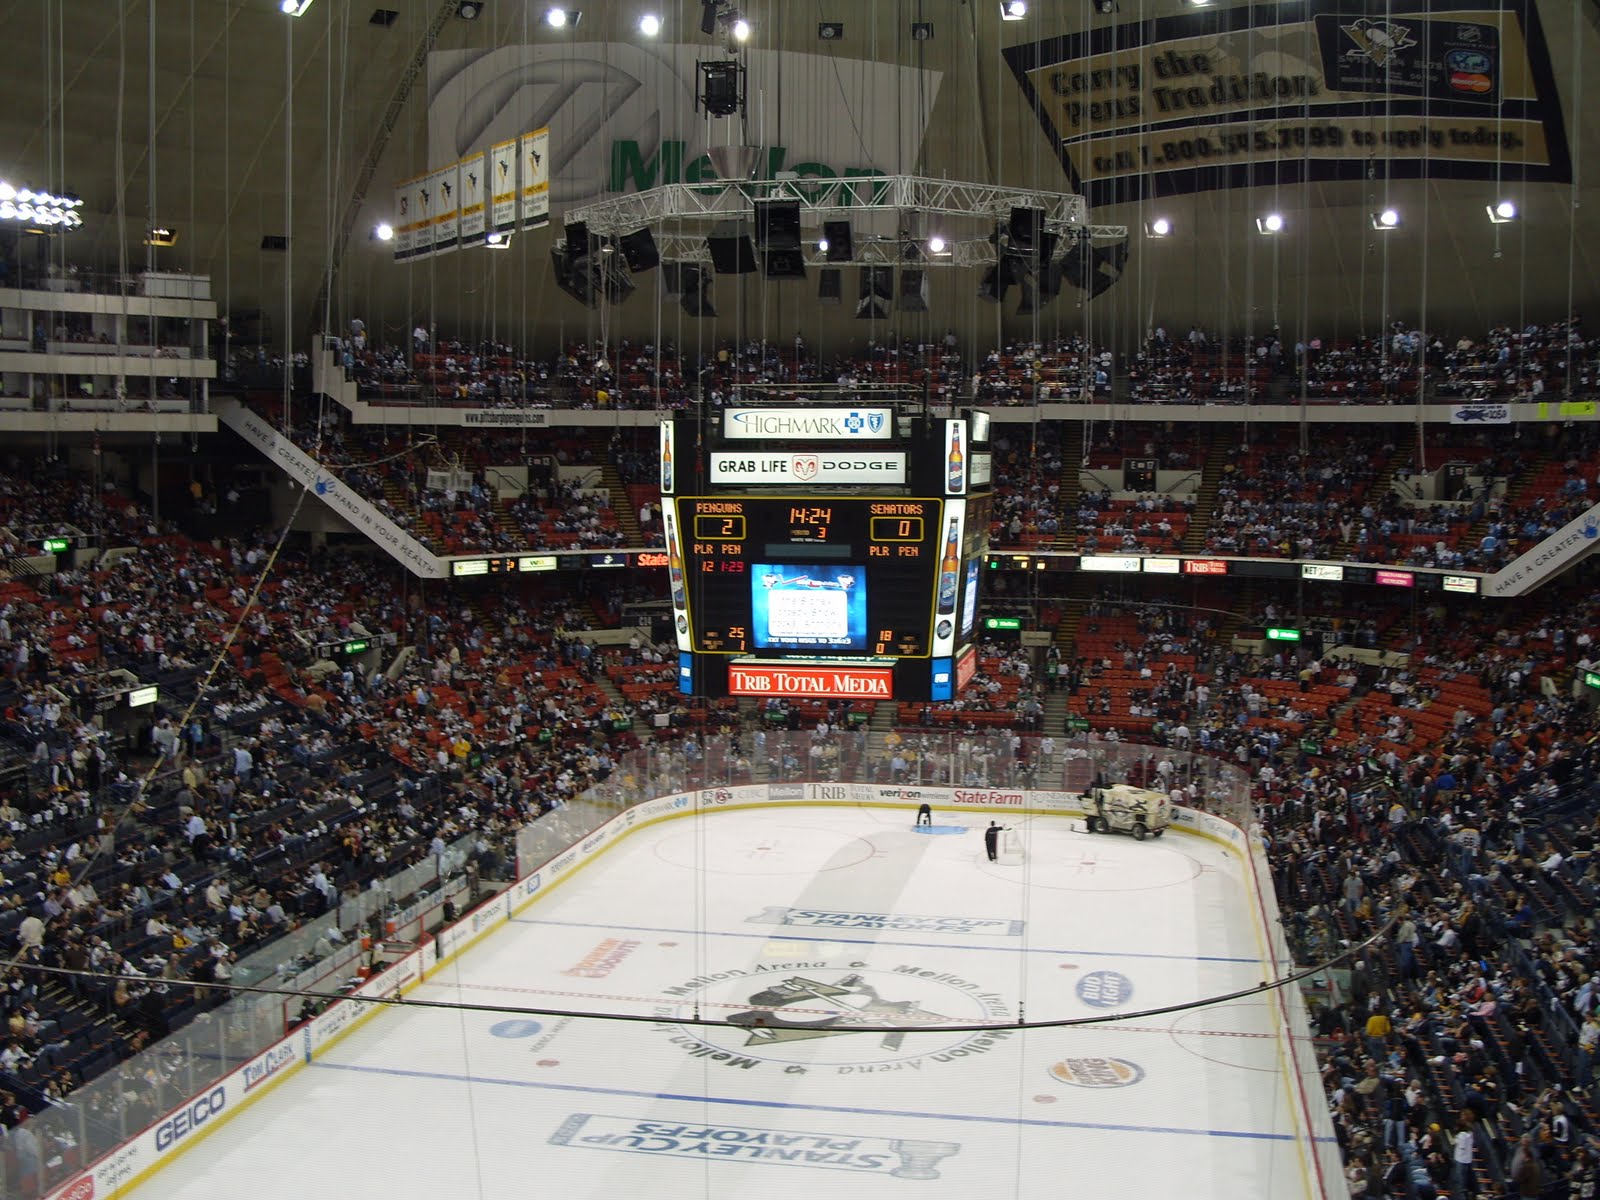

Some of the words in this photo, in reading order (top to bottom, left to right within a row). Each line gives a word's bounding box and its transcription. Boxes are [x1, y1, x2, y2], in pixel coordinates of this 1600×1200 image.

[1052, 63, 1142, 97] Carry
[1152, 50, 1212, 79] the
[1152, 72, 1320, 112] Tradition
[738, 411, 842, 436] HIGHMARK
[718, 460, 756, 473] GRAB
[761, 460, 788, 473] LIFE
[822, 460, 898, 471] DODGE
[245, 421, 267, 442] HAVE
[333, 491, 359, 515] HAND
[361, 512, 371, 525] IN
[374, 522, 399, 546] YOUR
[400, 545, 435, 574] HEALTH
[696, 502, 743, 513] PENGUINS
[870, 504, 923, 514] SENATORS
[789, 508, 832, 524] 14:24
[721, 519, 733, 535] 2
[817, 527, 827, 538] 3
[898, 520, 910, 536] 0
[694, 544, 713, 554] PLR
[722, 544, 741, 554] PEN
[870, 546, 889, 556] PLR
[898, 546, 919, 556] PEN
[637, 553, 669, 567] State
[702, 561, 714, 571] 12
[721, 561, 744, 572] 1:29
[1184, 560, 1208, 572] TRIB
[1496, 572, 1524, 593] HAVE
[1526, 565, 1534, 574] A
[729, 627, 745, 638] 25
[880, 631, 893, 641] 18
[875, 643, 885, 654] 0
[732, 672, 770, 691] TRIB
[773, 672, 830, 692] TOTAL
[833, 674, 889, 694] MEDIA
[770, 786, 802, 797] Mellon
[809, 784, 846, 800] TRIB
[879, 788, 921, 800] verizon
[954, 790, 989, 804] State
[989, 792, 1023, 805] Farm
[795, 911, 926, 925] STANLEY
[931, 917, 1005, 928] CUP
[810, 919, 975, 934] PLAYOFFS
[662, 969, 747, 997] Mellon
[755, 961, 828, 973] Arena
[892, 965, 980, 991] Mellon
[1082, 975, 1101, 1000] BUD
[1100, 974, 1120, 1006] LIGHT
[668, 1035, 762, 1070] Mellon
[931, 1029, 1014, 1063] Mellon
[837, 1058, 923, 1075] Arena
[156, 1086, 226, 1152] GEICO
[582, 1134, 682, 1153] CUP
[634, 1122, 862, 1151] PLAYOFFS
[690, 1141, 893, 1170] STANLEY
